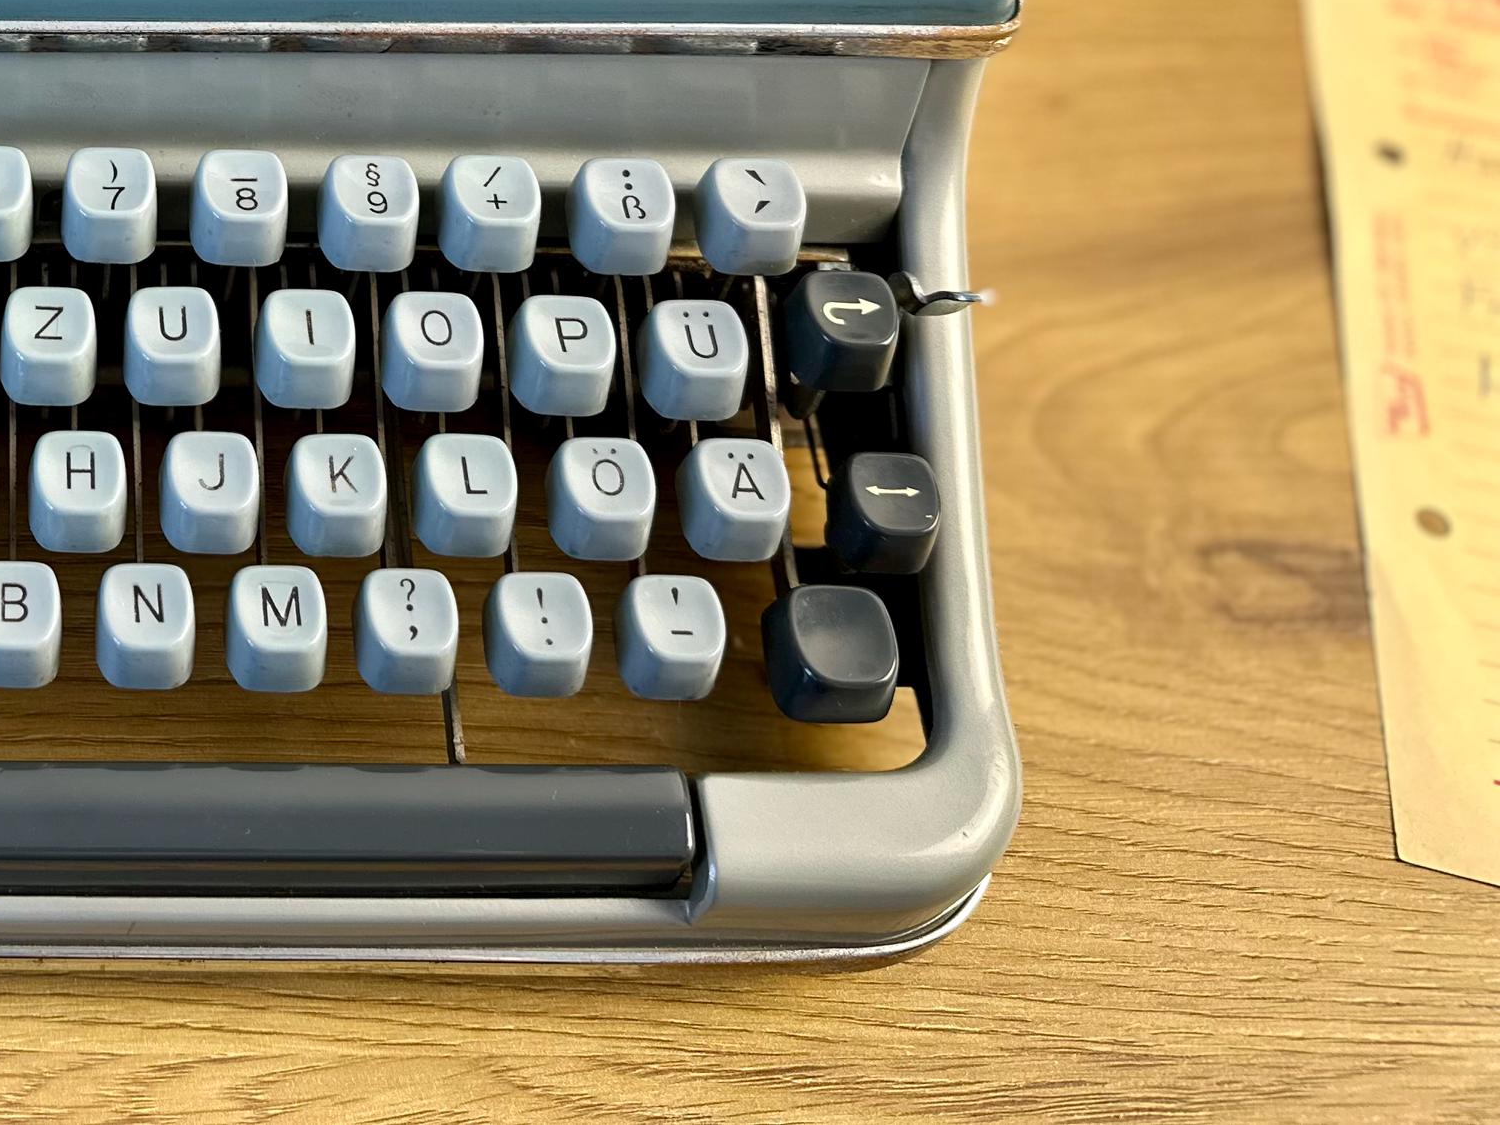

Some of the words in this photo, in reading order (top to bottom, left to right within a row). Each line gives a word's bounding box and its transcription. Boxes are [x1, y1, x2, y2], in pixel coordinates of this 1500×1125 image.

[483, 166, 501, 187] /
[102, 186, 125, 210] 7
[236, 187, 258, 211] 8
[367, 191, 388, 214] 9
[486, 193, 508, 210] +
[34, 305, 64, 341] Z
[159, 305, 187, 341] U
[305, 309, 314, 346] I
[420, 310, 454, 346] O
[555, 317, 589, 354] P
[683, 311, 720, 359] Ü
[66, 452, 96, 491] H
[198, 453, 225, 491] J
[329, 455, 358, 493] K
[461, 456, 488, 495] L
[592, 448, 625, 496] Ö
[727, 452, 768, 501] Ä
[1, 582, 28, 623] B
[133, 583, 165, 623] N
[261, 586, 303, 627] M
[400, 578, 415, 612] ?
[536, 587, 548, 624] !
